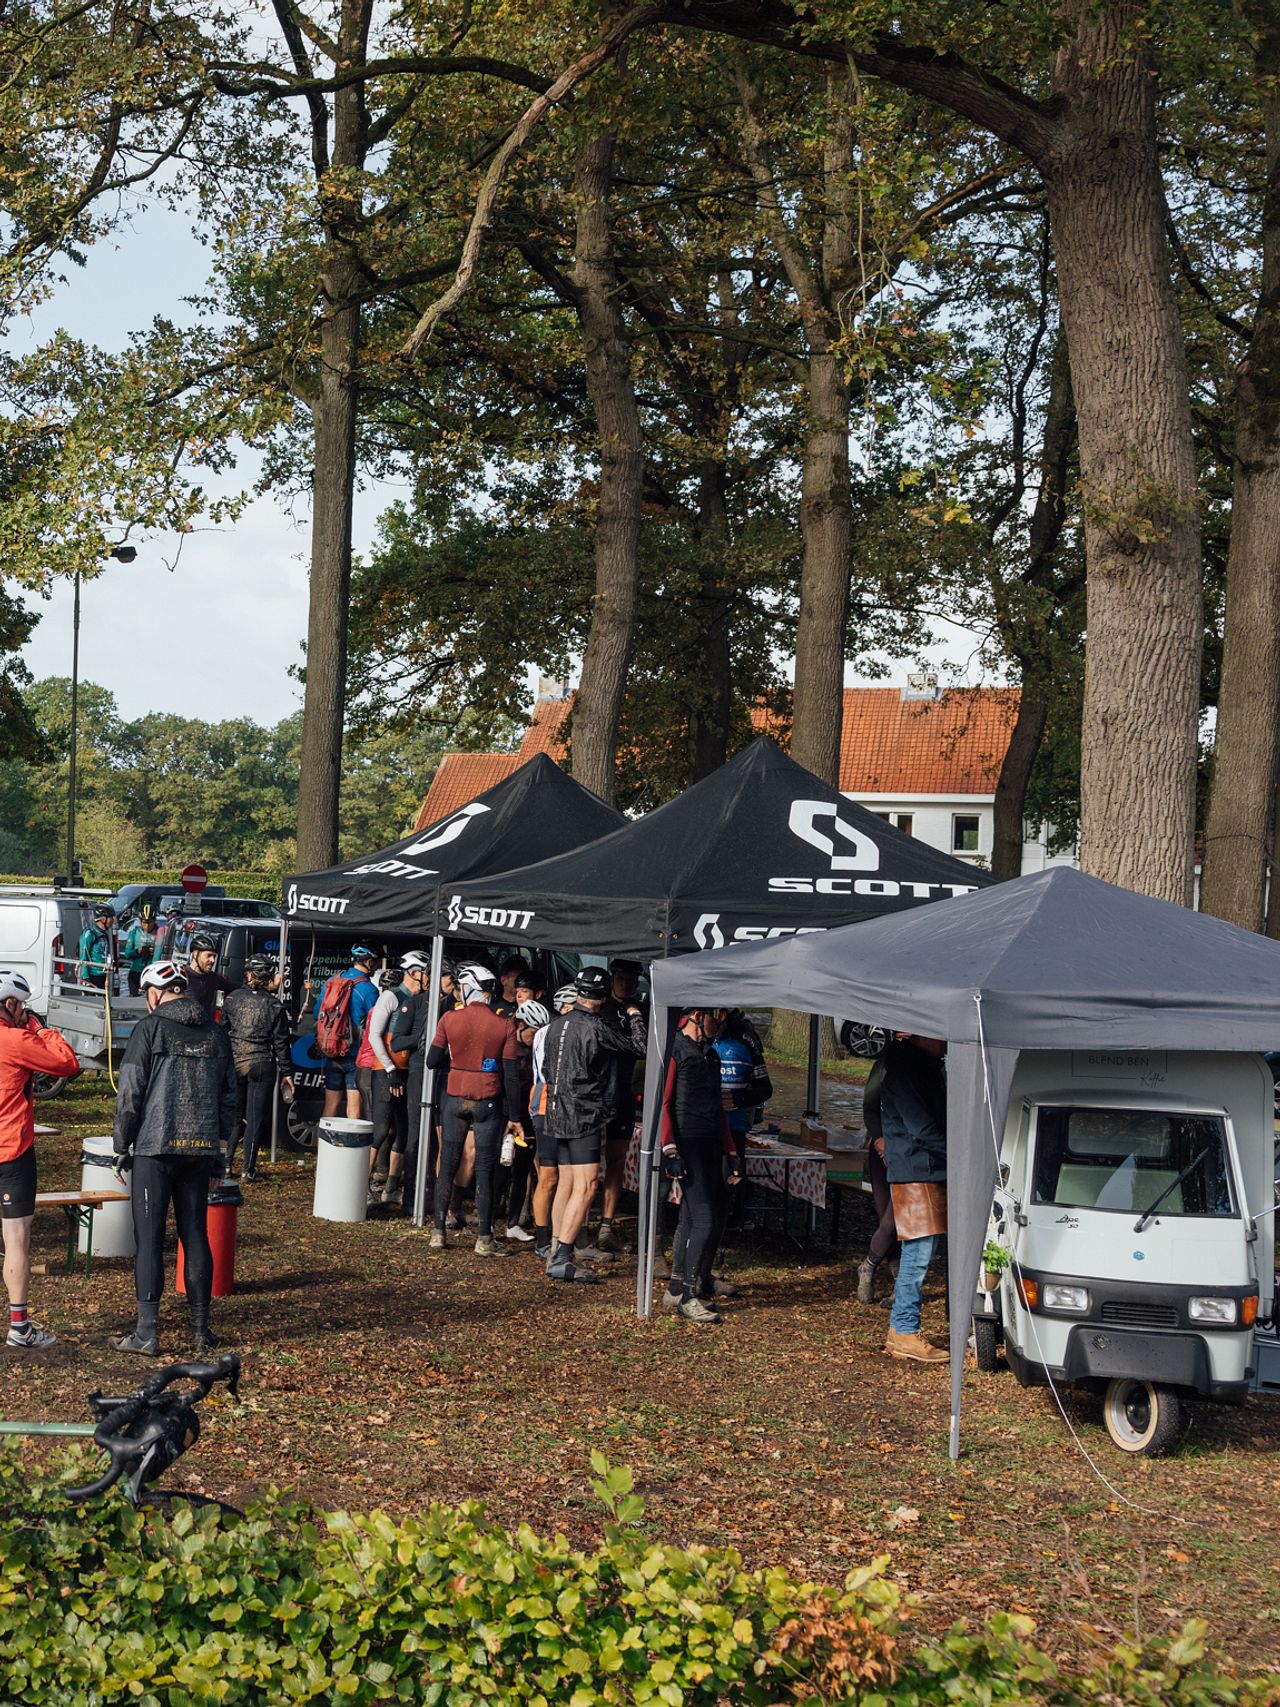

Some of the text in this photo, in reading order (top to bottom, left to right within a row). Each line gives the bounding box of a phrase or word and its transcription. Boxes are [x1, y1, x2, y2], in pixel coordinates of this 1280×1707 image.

[767, 877, 980, 899] SCOTT
[297, 894, 350, 915] SCOTT
[462, 906, 535, 930] SCOTT
[1088, 1055, 1124, 1066] BLEND
[303, 1073, 326, 1088] LIF
[168, 1138, 213, 1148] NIKE TRAIL
[1055, 1214, 1080, 1224] Ape
